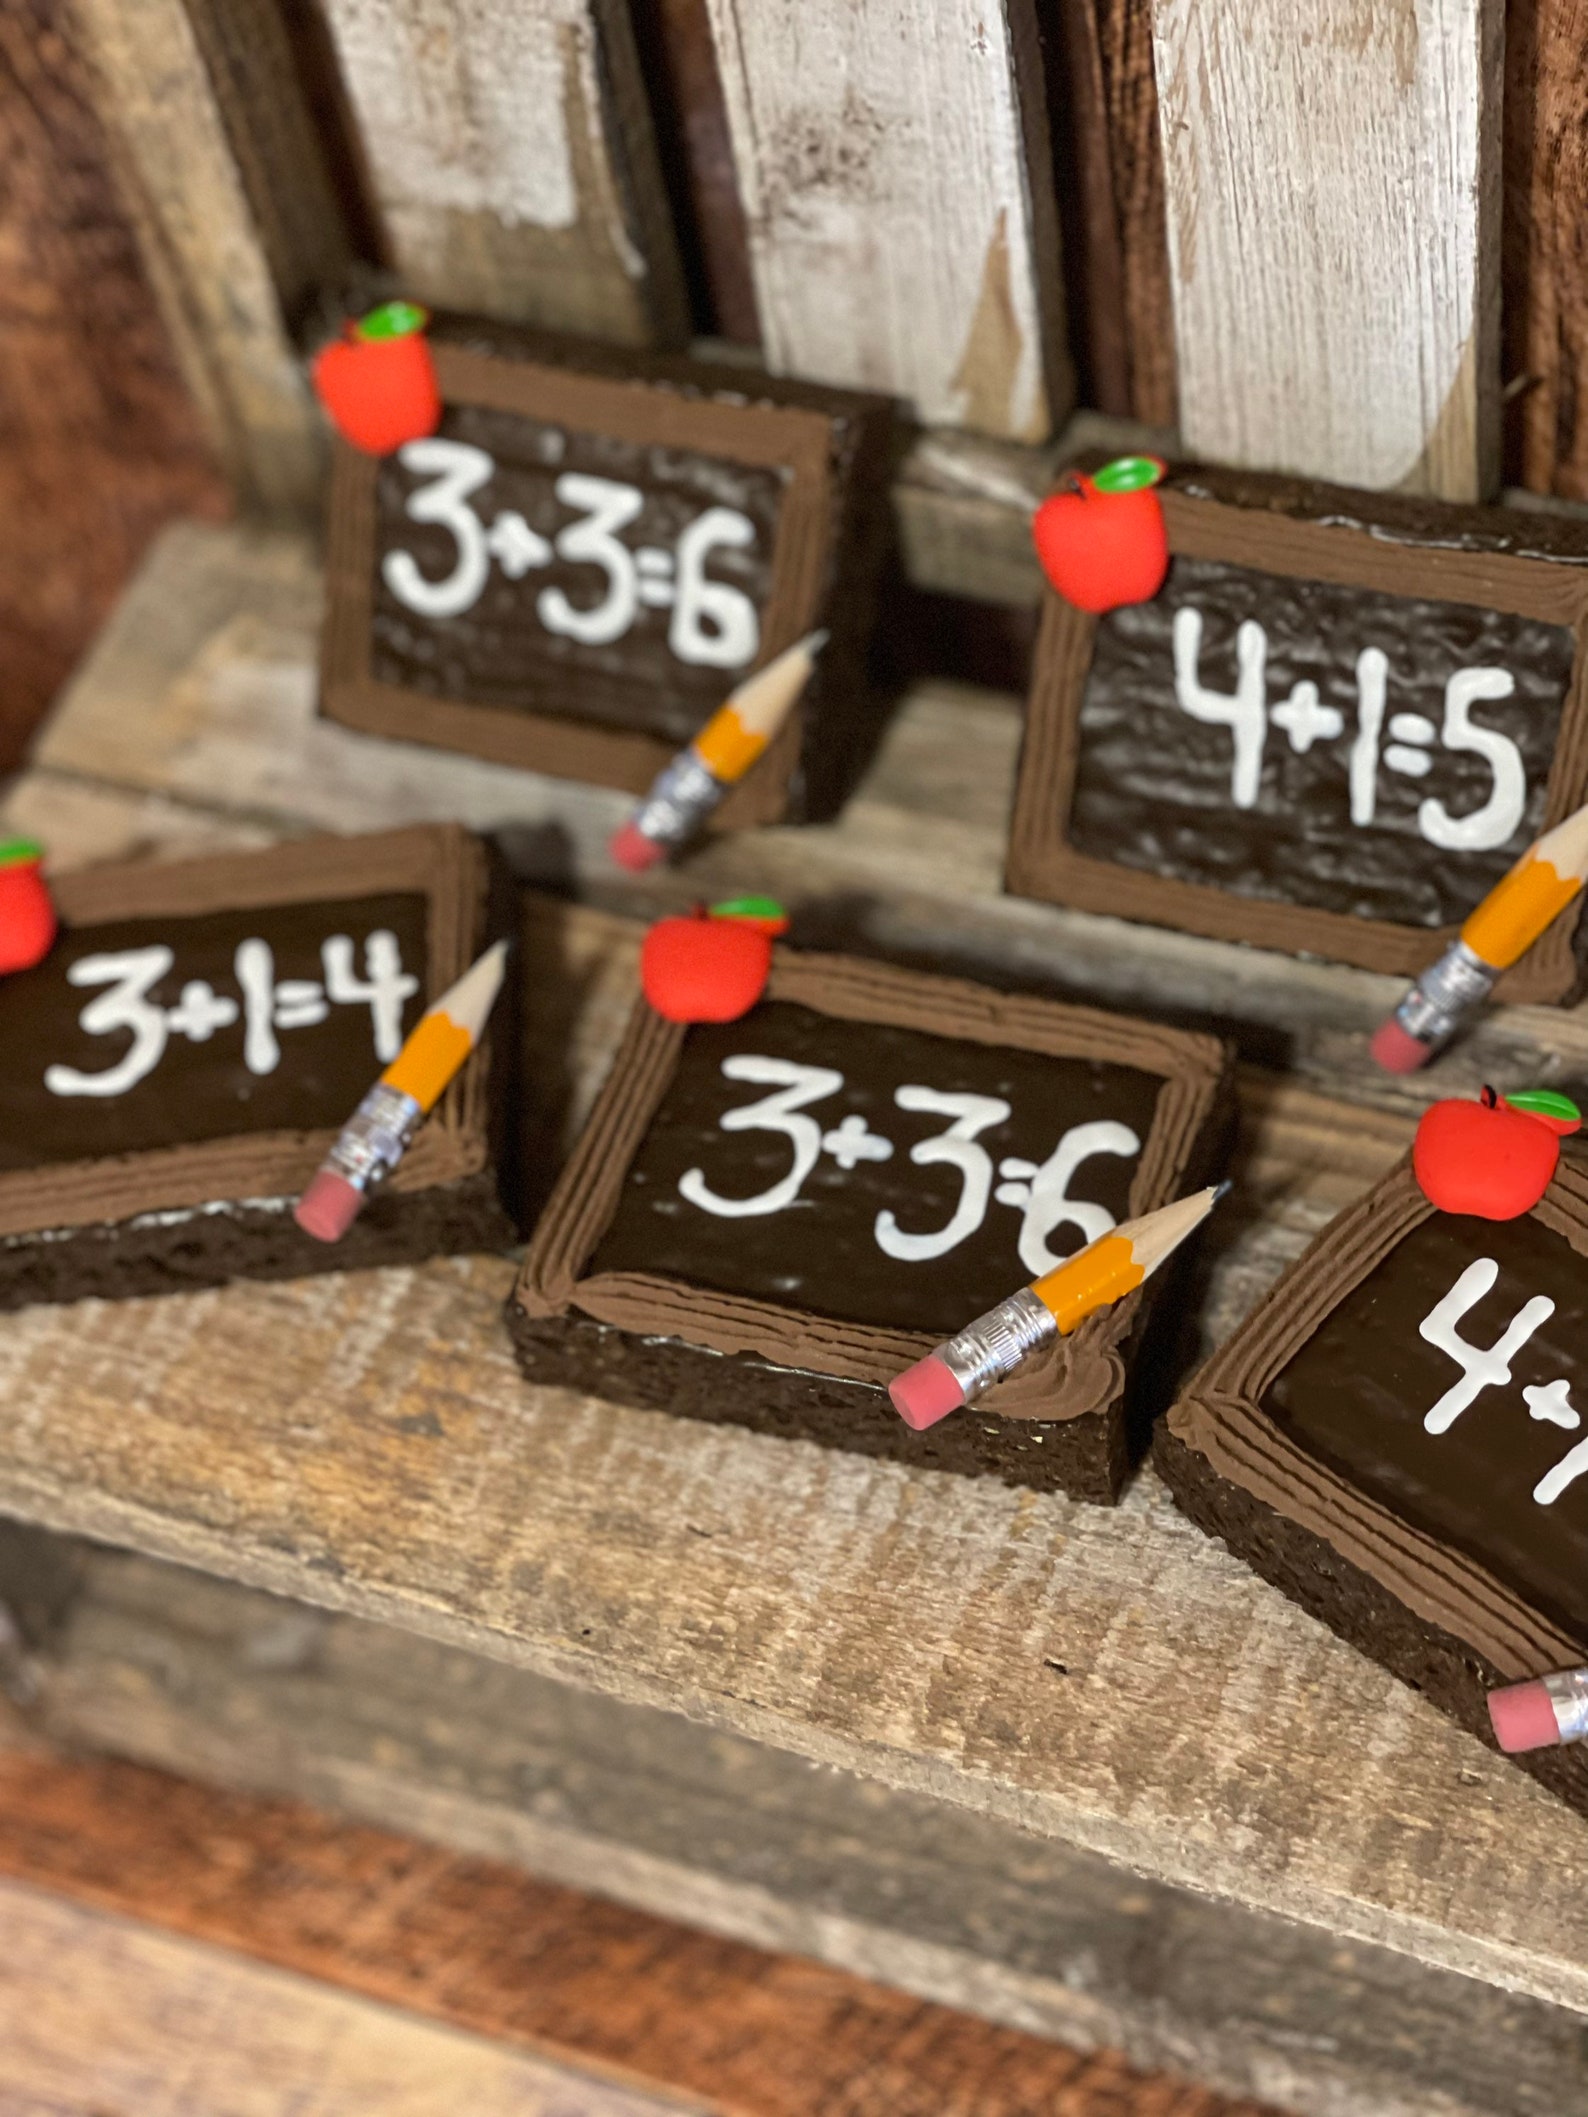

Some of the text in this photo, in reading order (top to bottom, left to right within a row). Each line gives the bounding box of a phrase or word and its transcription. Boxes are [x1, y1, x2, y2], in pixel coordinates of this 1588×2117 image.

[382, 437, 760, 668] 3+3=6
[1172, 606, 1526, 850] 4+1=5
[45, 929, 419, 1097] 3+1=4
[678, 1053, 1141, 1278] 3+3=6
